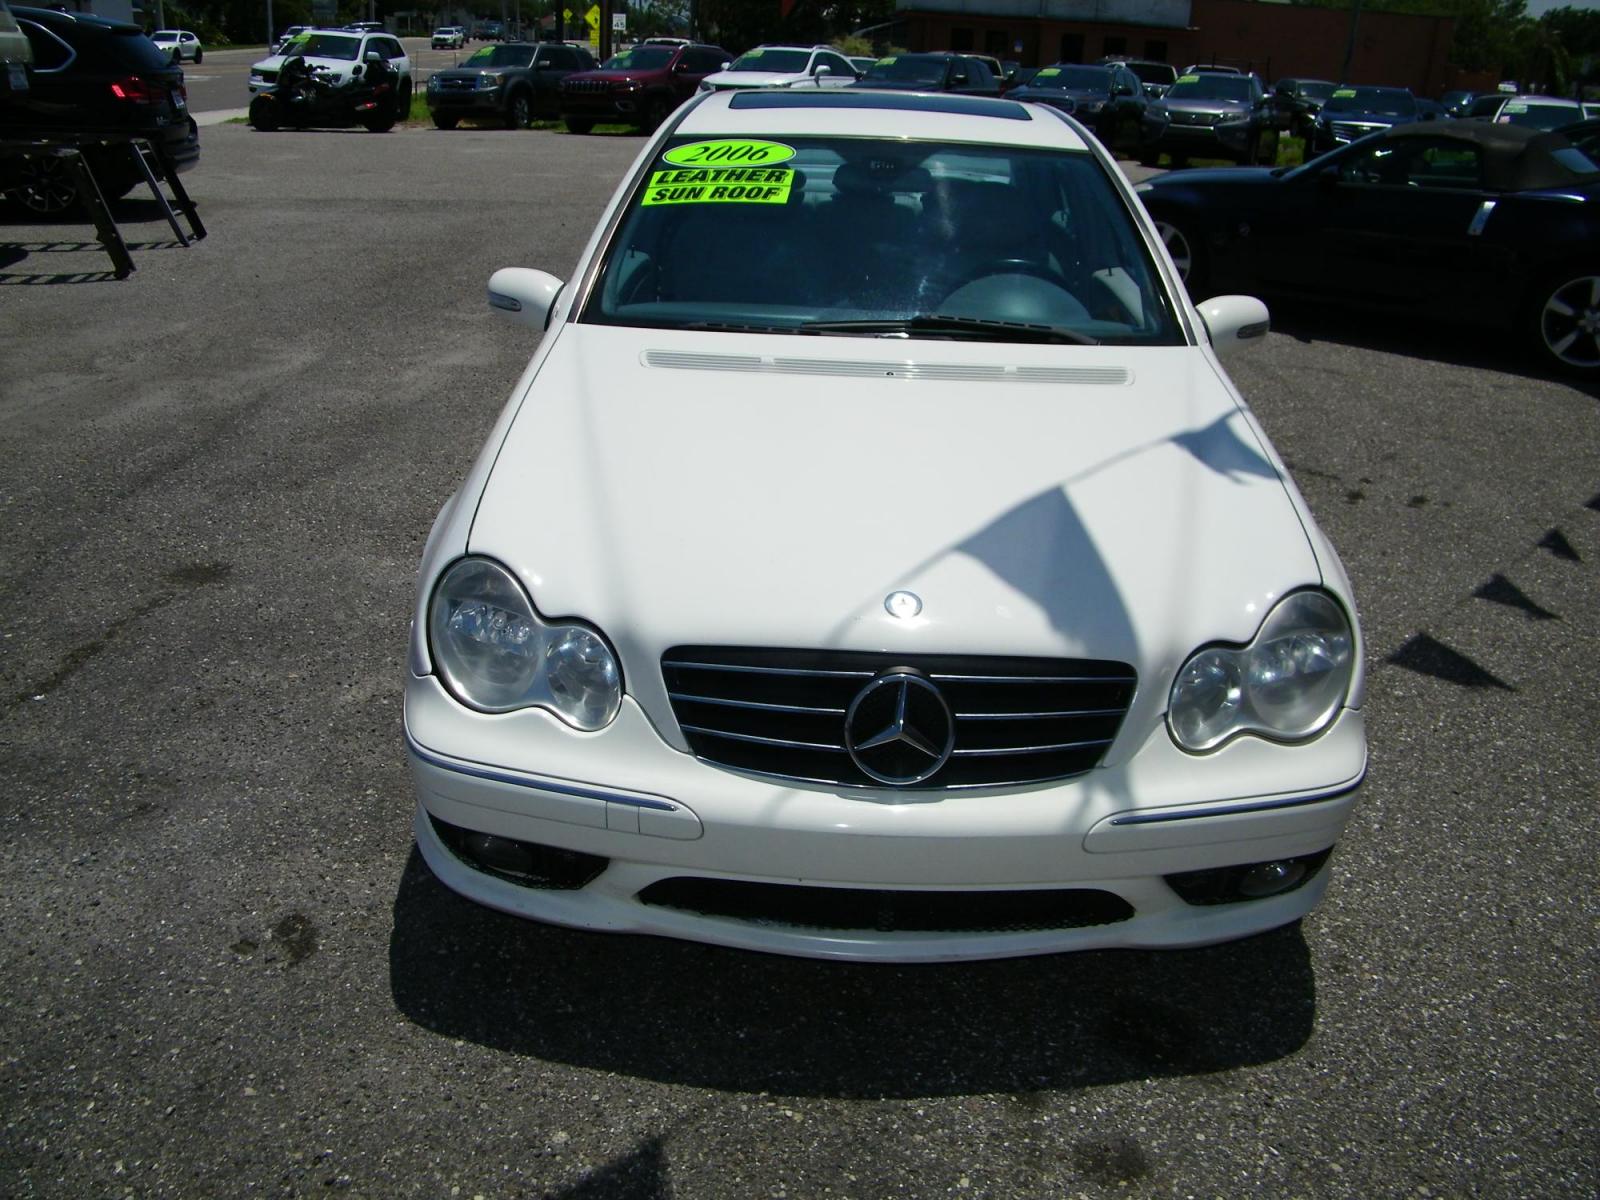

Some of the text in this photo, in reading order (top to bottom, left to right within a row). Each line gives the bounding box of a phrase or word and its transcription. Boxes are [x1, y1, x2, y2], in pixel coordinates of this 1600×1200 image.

[683, 145, 775, 162] 2006
[655, 169, 788, 184] LEATHER
[651, 186, 782, 202] SUN ROOF
